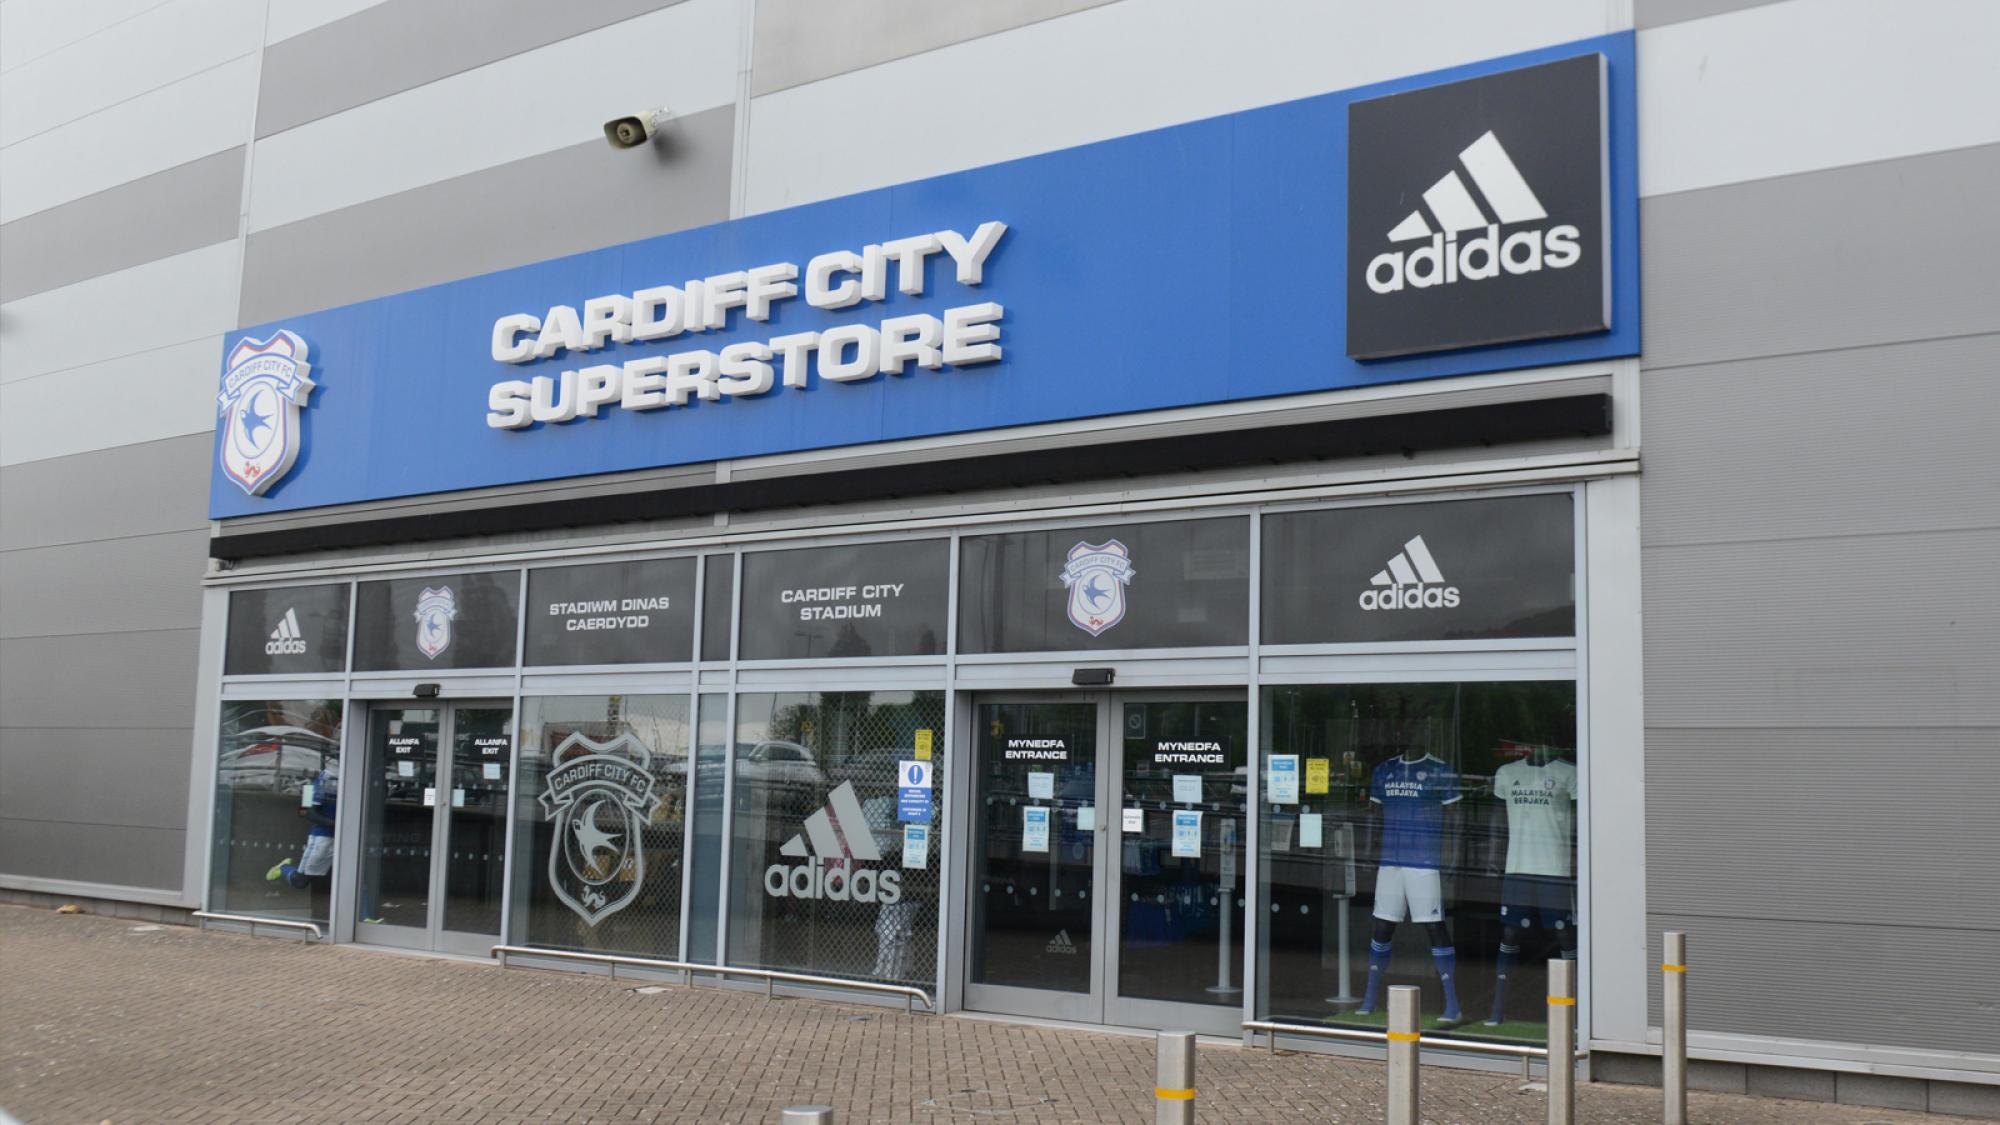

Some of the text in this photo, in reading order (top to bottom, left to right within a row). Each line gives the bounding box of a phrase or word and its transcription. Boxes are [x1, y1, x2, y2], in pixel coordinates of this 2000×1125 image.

[1366, 223, 1581, 294] adidas
[491, 220, 1008, 364] CARDIFF CITY
[486, 302, 1004, 430] SUPERSTORE
[229, 359, 292, 389] CARDIFF CITY FC
[781, 584, 904, 603] CARDIFF CITY
[1359, 582, 1460, 611] adidas
[549, 597, 670, 615] STADIWM DINAS
[800, 604, 881, 620] STADIUM
[566, 615, 649, 631] CAERDYDD
[265, 638, 306, 655] adidas
[389, 738, 419, 746] ALLANFA
[474, 738, 508, 746] ALLANFA
[1008, 740, 1065, 749] MYNEDFA
[1158, 742, 1221, 751] MYNEDFA
[395, 746, 412, 754] EXIT
[482, 747, 499, 755] EXIT
[1005, 751, 1068, 760] ENTRANCE
[1154, 753, 1225, 763] ENTRANCE
[554, 763, 646, 792] CARDIFF CITY FC
[1384, 781, 1423, 790] MALAYSIA
[1386, 789, 1418, 797] BERJAYA
[1512, 789, 1553, 798] MALAYSIA
[1514, 797, 1550, 805] BERJAYA
[765, 856, 901, 904] adidas
[1045, 944, 1077, 954] adidas
